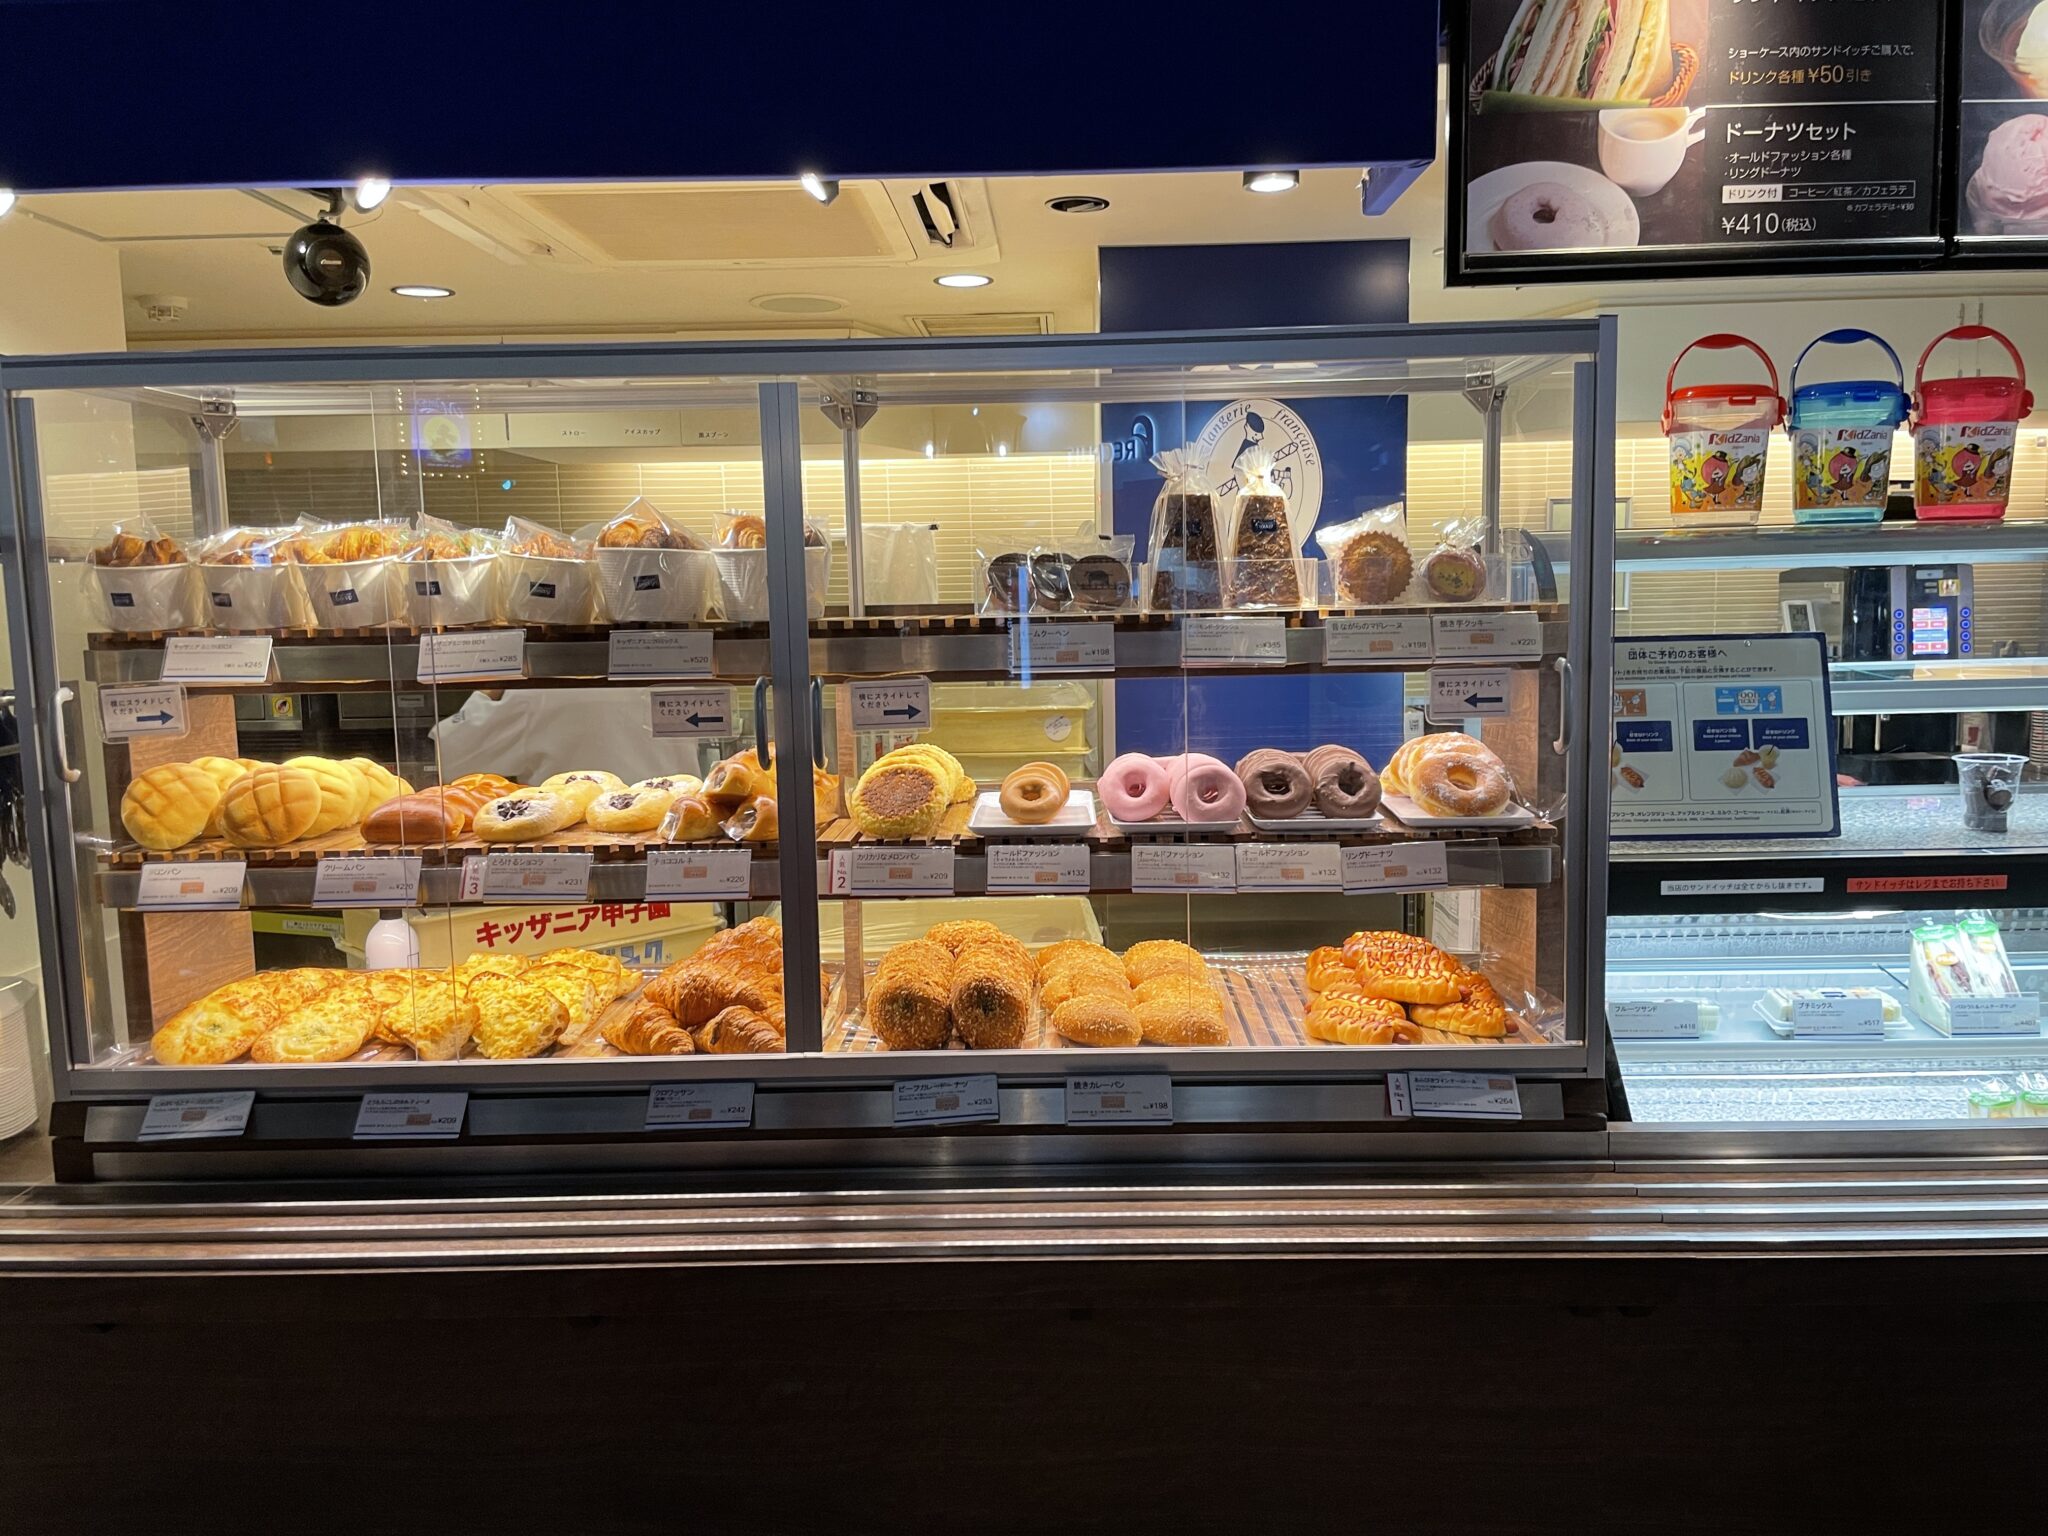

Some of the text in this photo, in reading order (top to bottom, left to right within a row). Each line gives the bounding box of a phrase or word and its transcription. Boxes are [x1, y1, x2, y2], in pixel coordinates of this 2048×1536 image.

[1727, 121, 1857, 143] ドーナツセット
[1728, 188, 1778, 199] ドリンク付
[1836, 428, 1888, 441] KidZania
[1960, 426, 2012, 438] KidZania
[1270, 408, 1315, 466] française
[1708, 433, 1761, 446] KidZania
[1018, 629, 1070, 638] ームクーヘン
[1517, 638, 1537, 646] ¥220
[1628, 648, 1728, 660] 団体ご予約のお客様へ
[1437, 679, 1502, 689] 横にスライドして
[858, 691, 921, 700] 横にスライドして
[1438, 688, 1470, 696] ください
[658, 699, 722, 708] 横にスライドして
[859, 700, 890, 708] ください
[112, 707, 143, 715] ください
[659, 708, 691, 716] ください
[856, 852, 920, 861] カリカリなメロンパン
[993, 849, 1060, 857] オールドファッション
[1137, 850, 1204, 858] オールドファッション
[1242, 849, 1310, 857] オールドファッション
[1345, 849, 1394, 860] リングドーナツ
[491, 858, 545, 866] とろけるショコラ
[653, 857, 693, 865] チョココルネ
[323, 863, 366, 872] クリームパン
[1318, 868, 1337, 876] ¥132
[1423, 866, 1442, 874] ¥132
[930, 872, 948, 880] ¥209
[1066, 869, 1086, 877] ¥132
[564, 878, 583, 886] ¥231
[726, 875, 745, 883] ¥220
[837, 876, 846, 889] 2
[1855, 877, 2000, 890] サンドイッチはレジまでお持ち下さい
[219, 886, 238, 894] ¥209
[469, 882, 479, 895] 3
[475, 902, 672, 948] キッザニア甲子園
[1615, 1005, 1658, 1013] フルーツサンド
[1073, 1080, 1125, 1089] 焼きカレーパン
[655, 1088, 695, 1096] クロワッサン
[1395, 1099, 1403, 1112] 1
